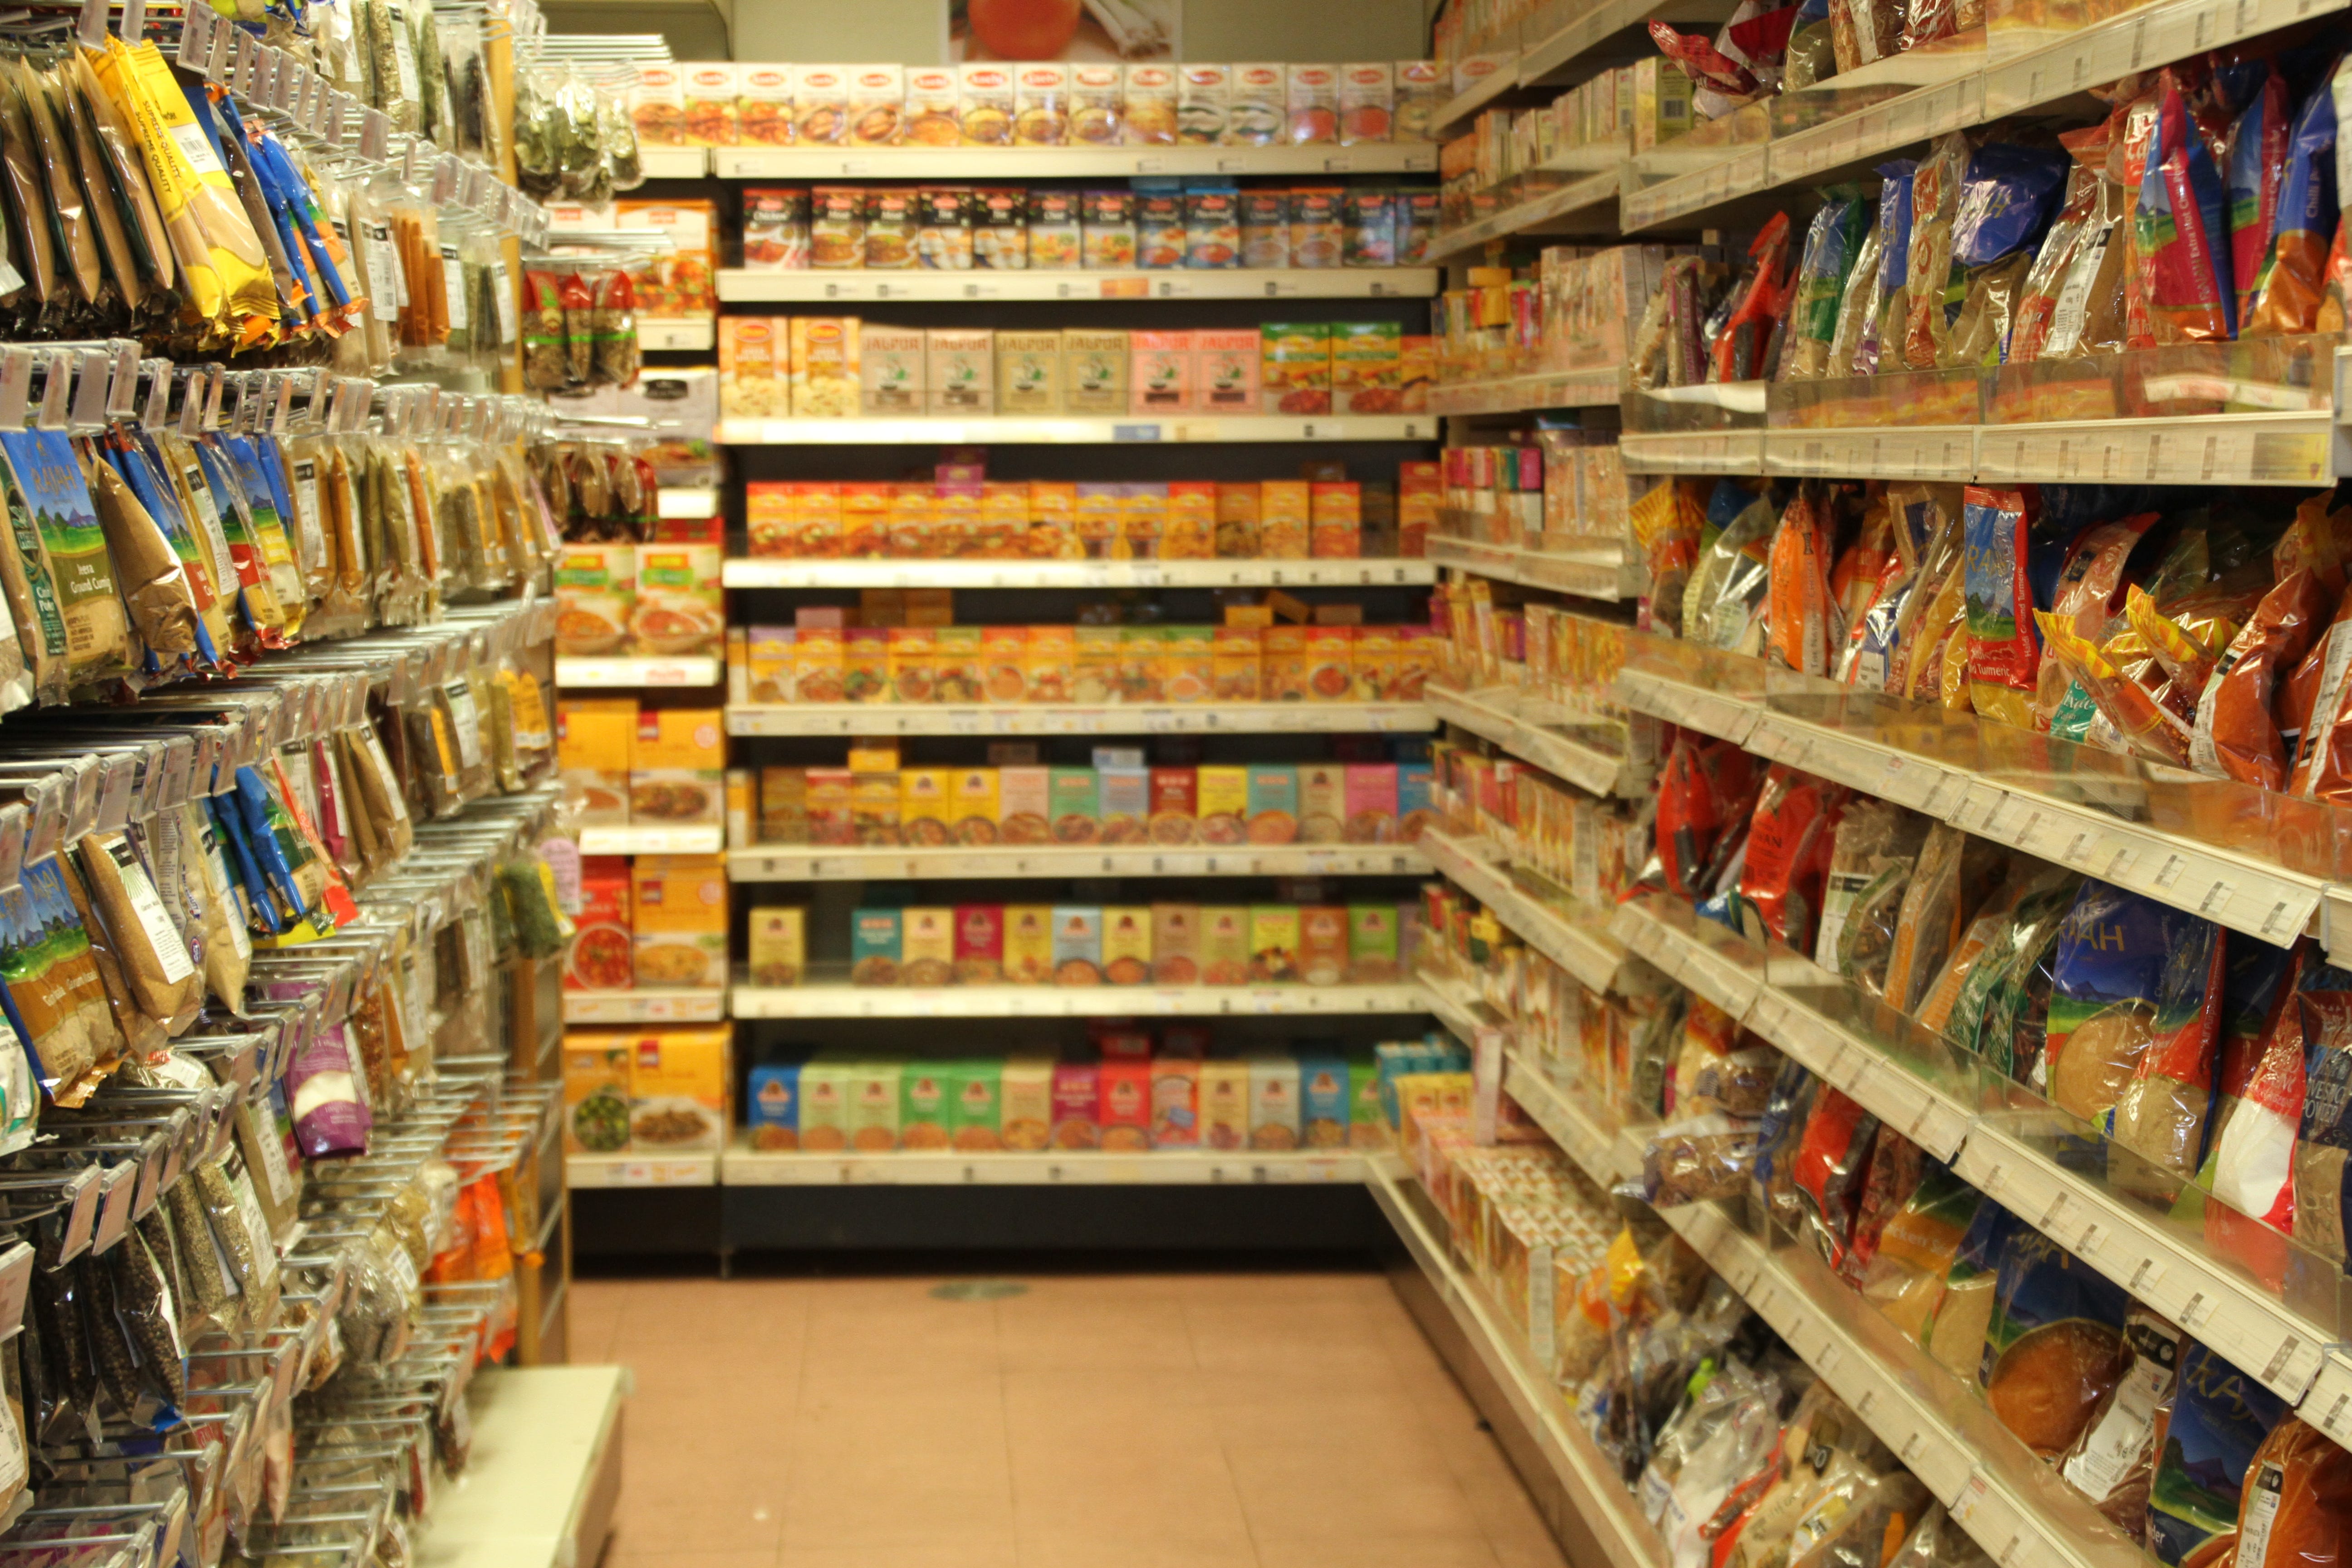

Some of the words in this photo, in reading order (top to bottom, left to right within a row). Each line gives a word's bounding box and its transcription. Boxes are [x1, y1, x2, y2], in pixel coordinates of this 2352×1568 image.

[136, 111, 156, 153] SUPREME
[152, 154, 172, 193] QUALITY
[142, 100, 164, 139] SUPREME
[161, 142, 181, 179] QUALITY
[2306, 183, 2321, 218] Chilli
[2183, 210, 2192, 228] Hot
[2188, 233, 2201, 259] Extra
[2018, 567, 2026, 600] Turmeric
[2018, 603, 2027, 634] Ground
[2021, 635, 2031, 658] Haldi
[1979, 663, 2010, 677] Turmeric
